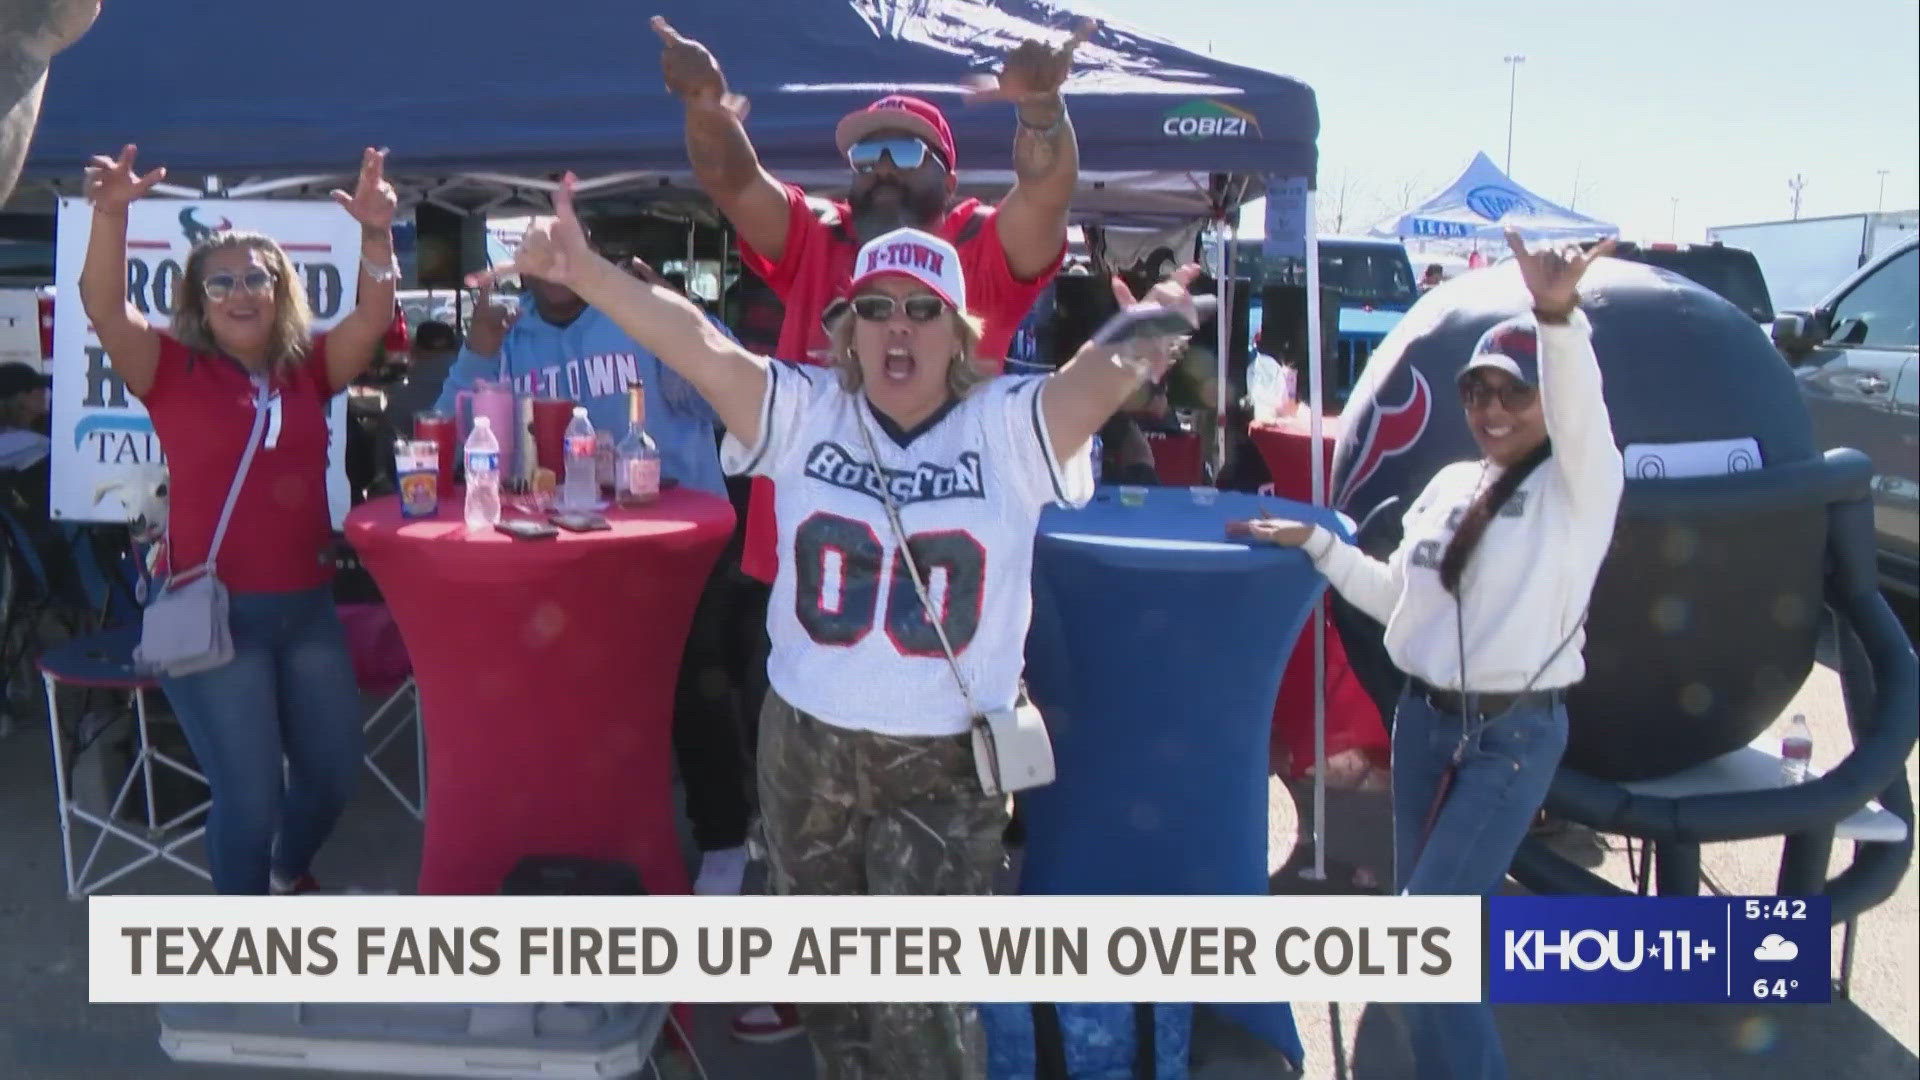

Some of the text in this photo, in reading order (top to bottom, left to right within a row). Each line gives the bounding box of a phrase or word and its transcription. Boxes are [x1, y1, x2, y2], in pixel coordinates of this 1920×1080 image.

[1163, 117, 1247, 136] COBIZI
[1417, 221, 1462, 236] TEAM
[795, 510, 987, 658] 00
